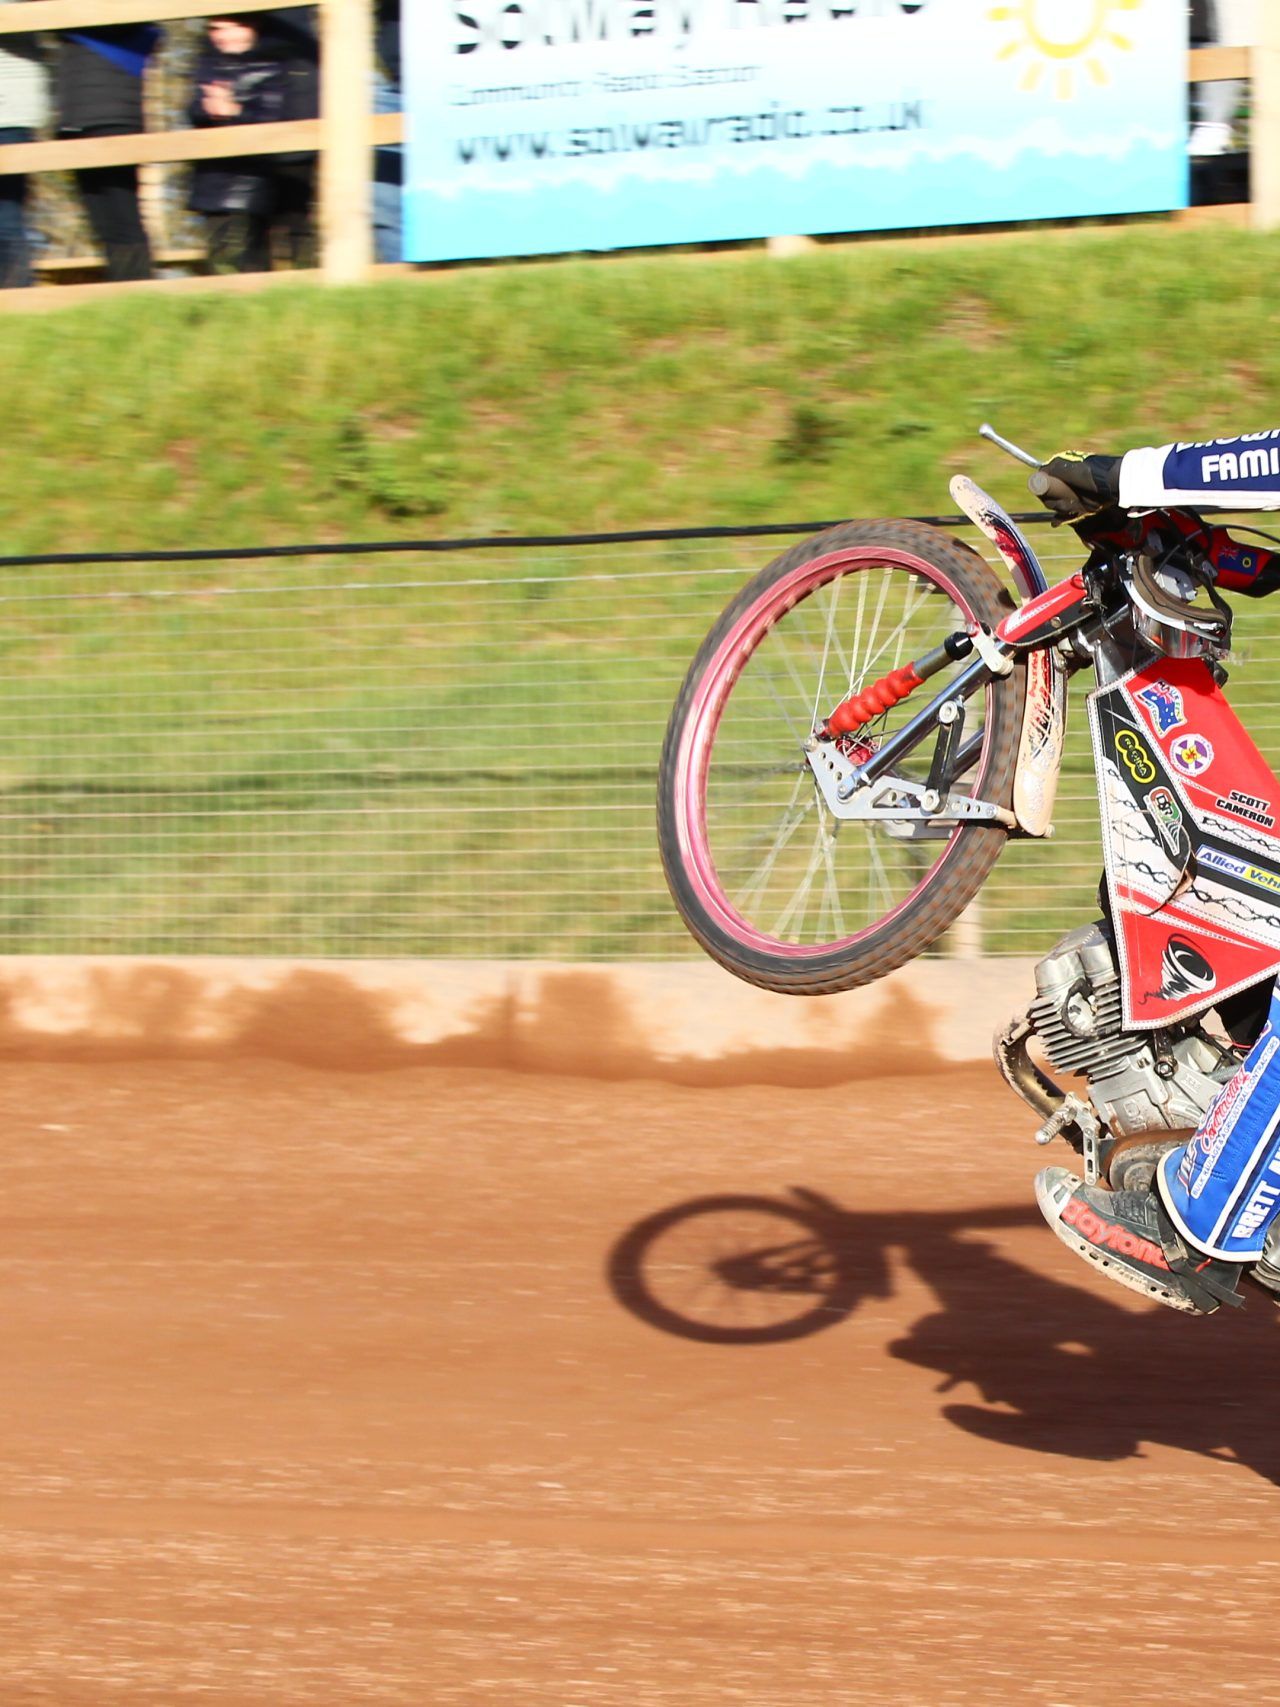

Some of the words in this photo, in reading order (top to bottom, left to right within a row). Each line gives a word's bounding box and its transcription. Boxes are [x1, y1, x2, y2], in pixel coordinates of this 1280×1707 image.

[1216, 799, 1274, 827] CAMERON
[1229, 791, 1269, 811] SCOTT
[1201, 852, 1246, 875] Allied
[1231, 1180, 1280, 1239] BRETT
